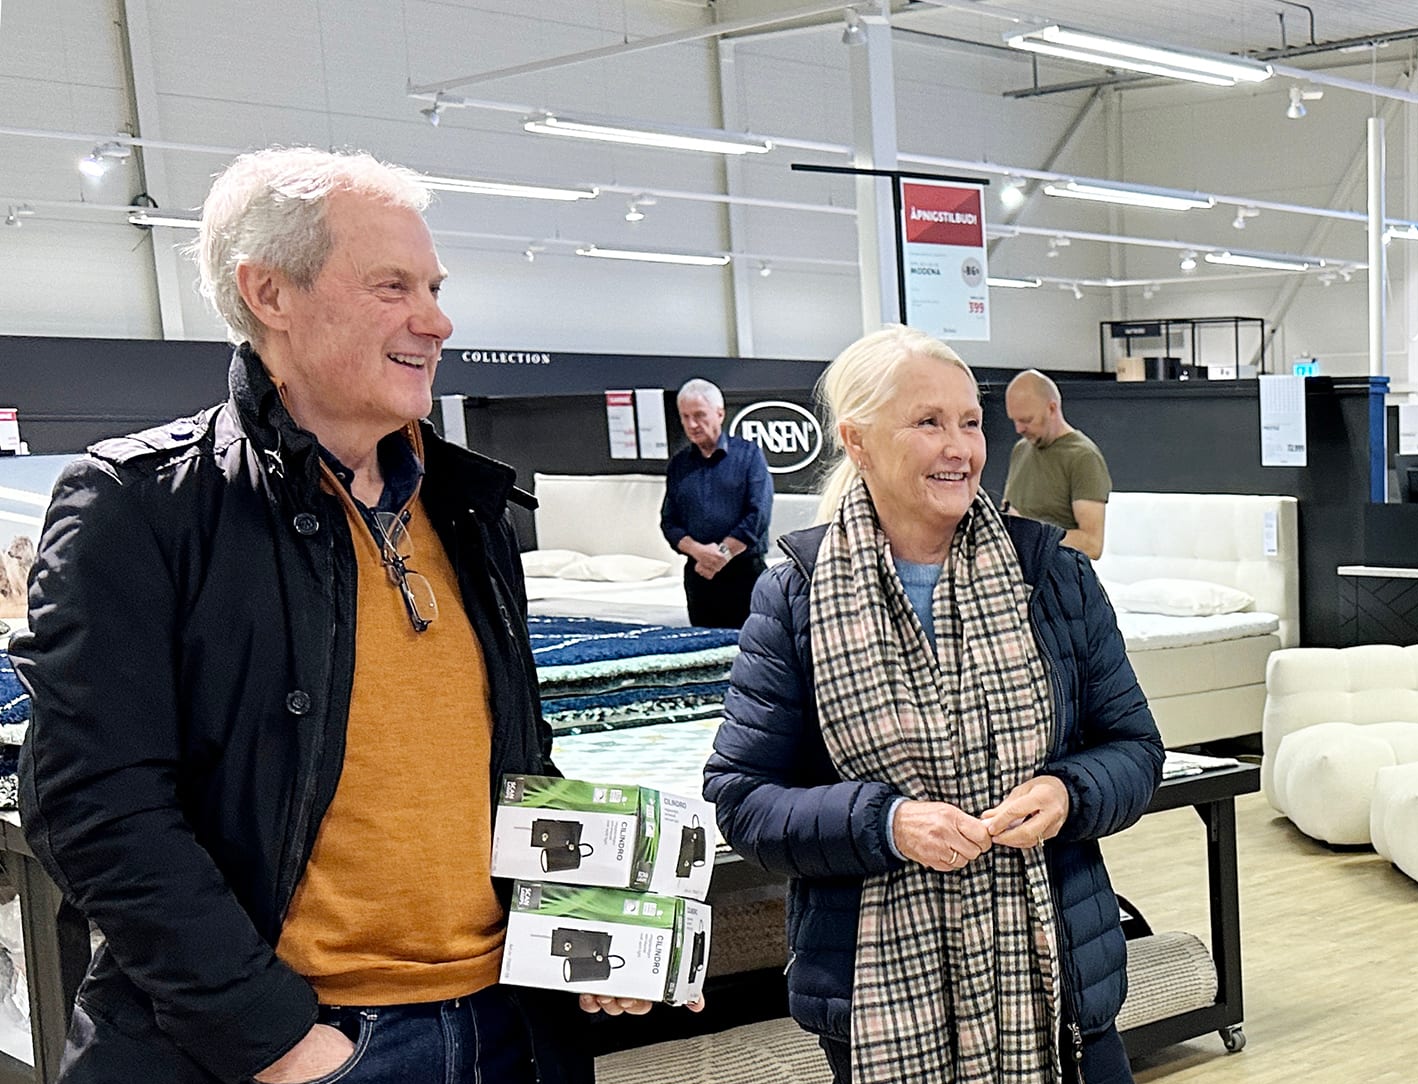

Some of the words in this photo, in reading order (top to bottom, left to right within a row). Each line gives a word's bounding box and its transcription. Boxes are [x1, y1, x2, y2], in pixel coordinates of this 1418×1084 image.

[462, 351, 550, 364] COLLECTION
[616, 821, 628, 861] CILINDRO
[652, 935, 664, 974] CILINDRO
